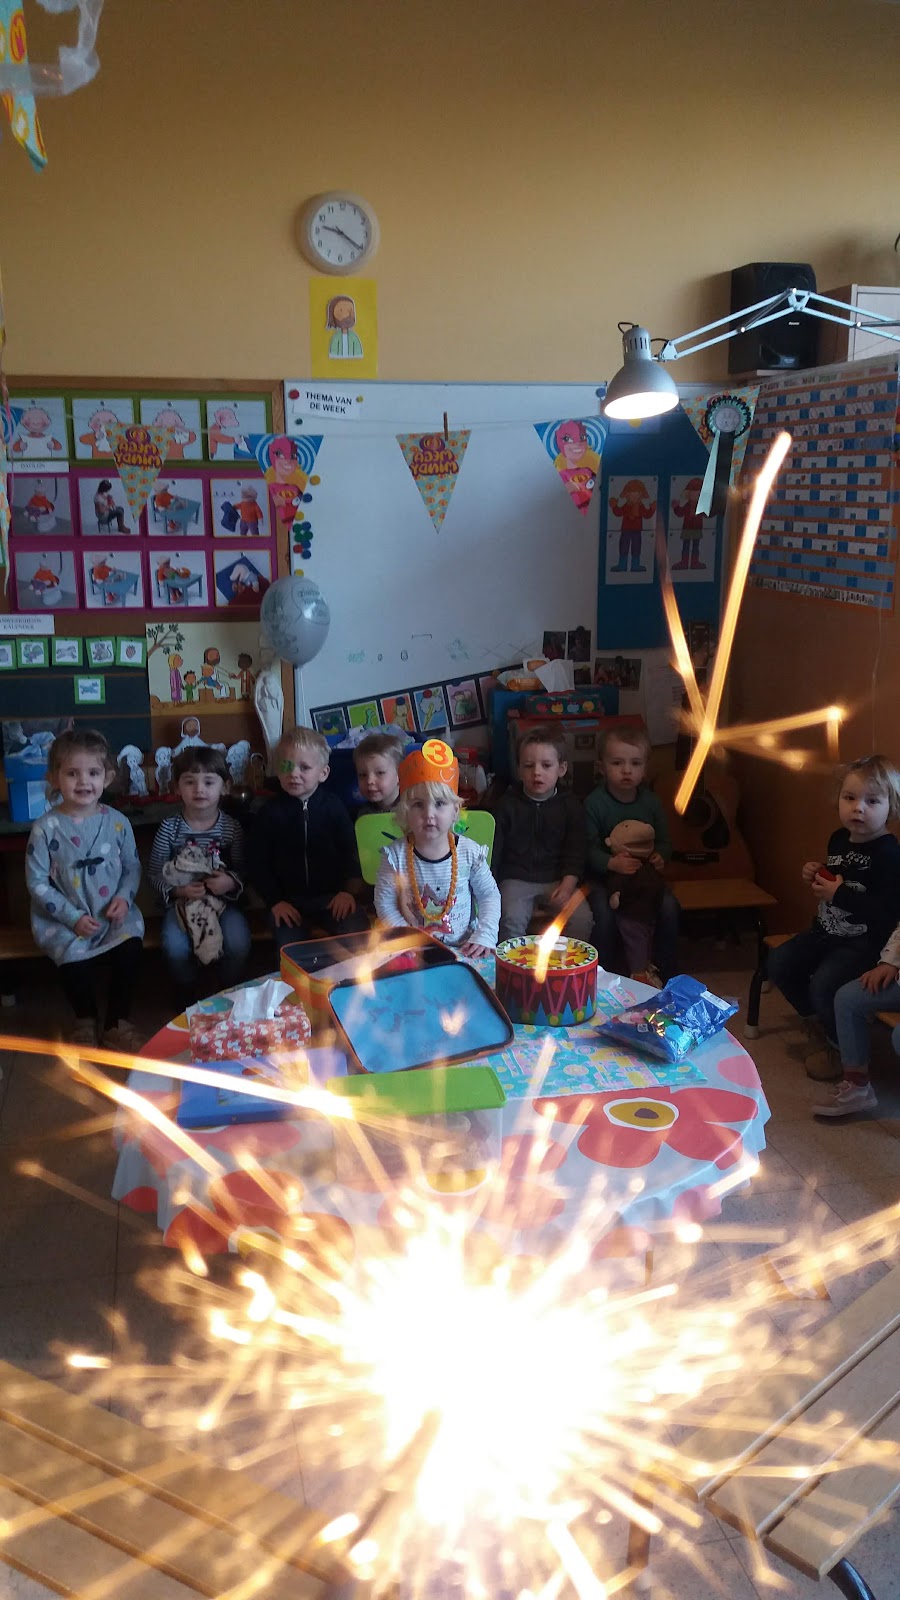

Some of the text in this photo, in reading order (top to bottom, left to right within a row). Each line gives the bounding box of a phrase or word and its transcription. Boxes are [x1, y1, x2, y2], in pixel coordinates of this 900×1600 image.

[305, 391, 353, 405] THEMA VAN
[309, 402, 346, 414] DE WEEK
[426, 742, 449, 765] 3
